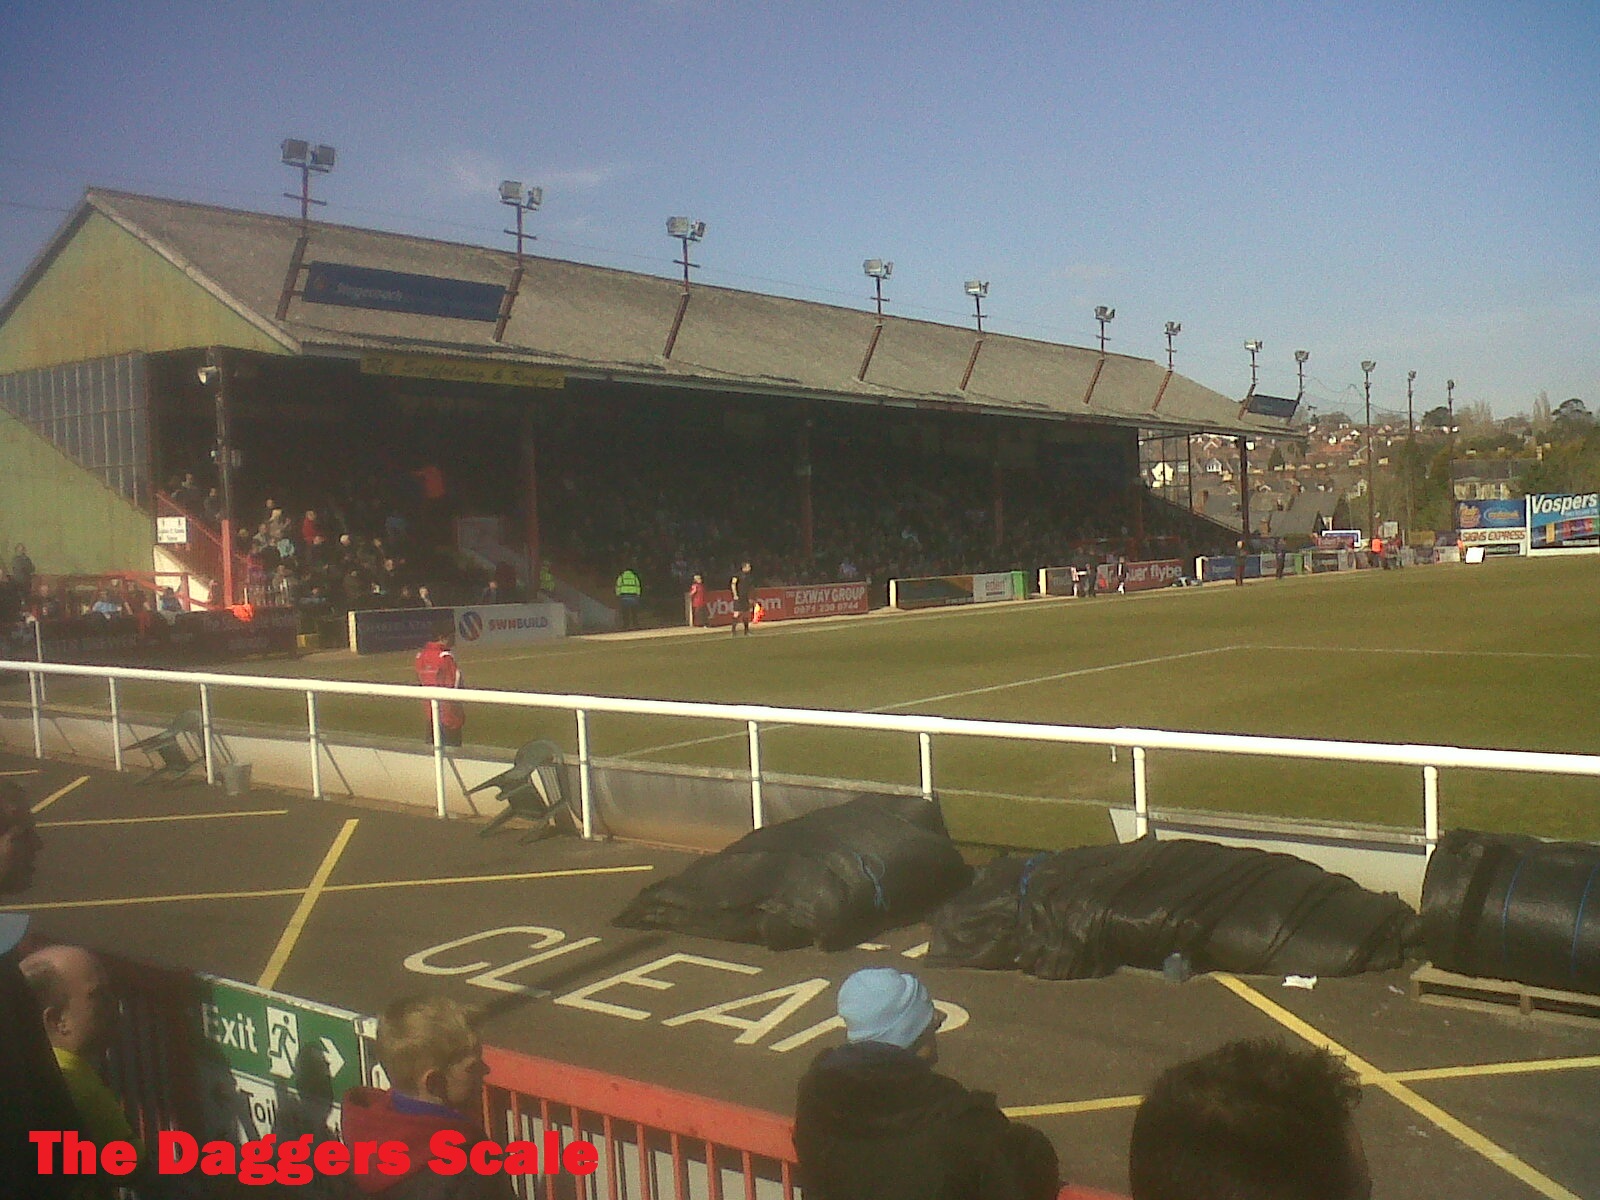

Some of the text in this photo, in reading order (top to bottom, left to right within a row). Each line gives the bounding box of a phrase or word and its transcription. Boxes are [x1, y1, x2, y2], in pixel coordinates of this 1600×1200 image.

[1532, 493, 1598, 515] Vospers
[832, 586, 865, 602] GROUP
[201, 1003, 258, 1054] Exit
